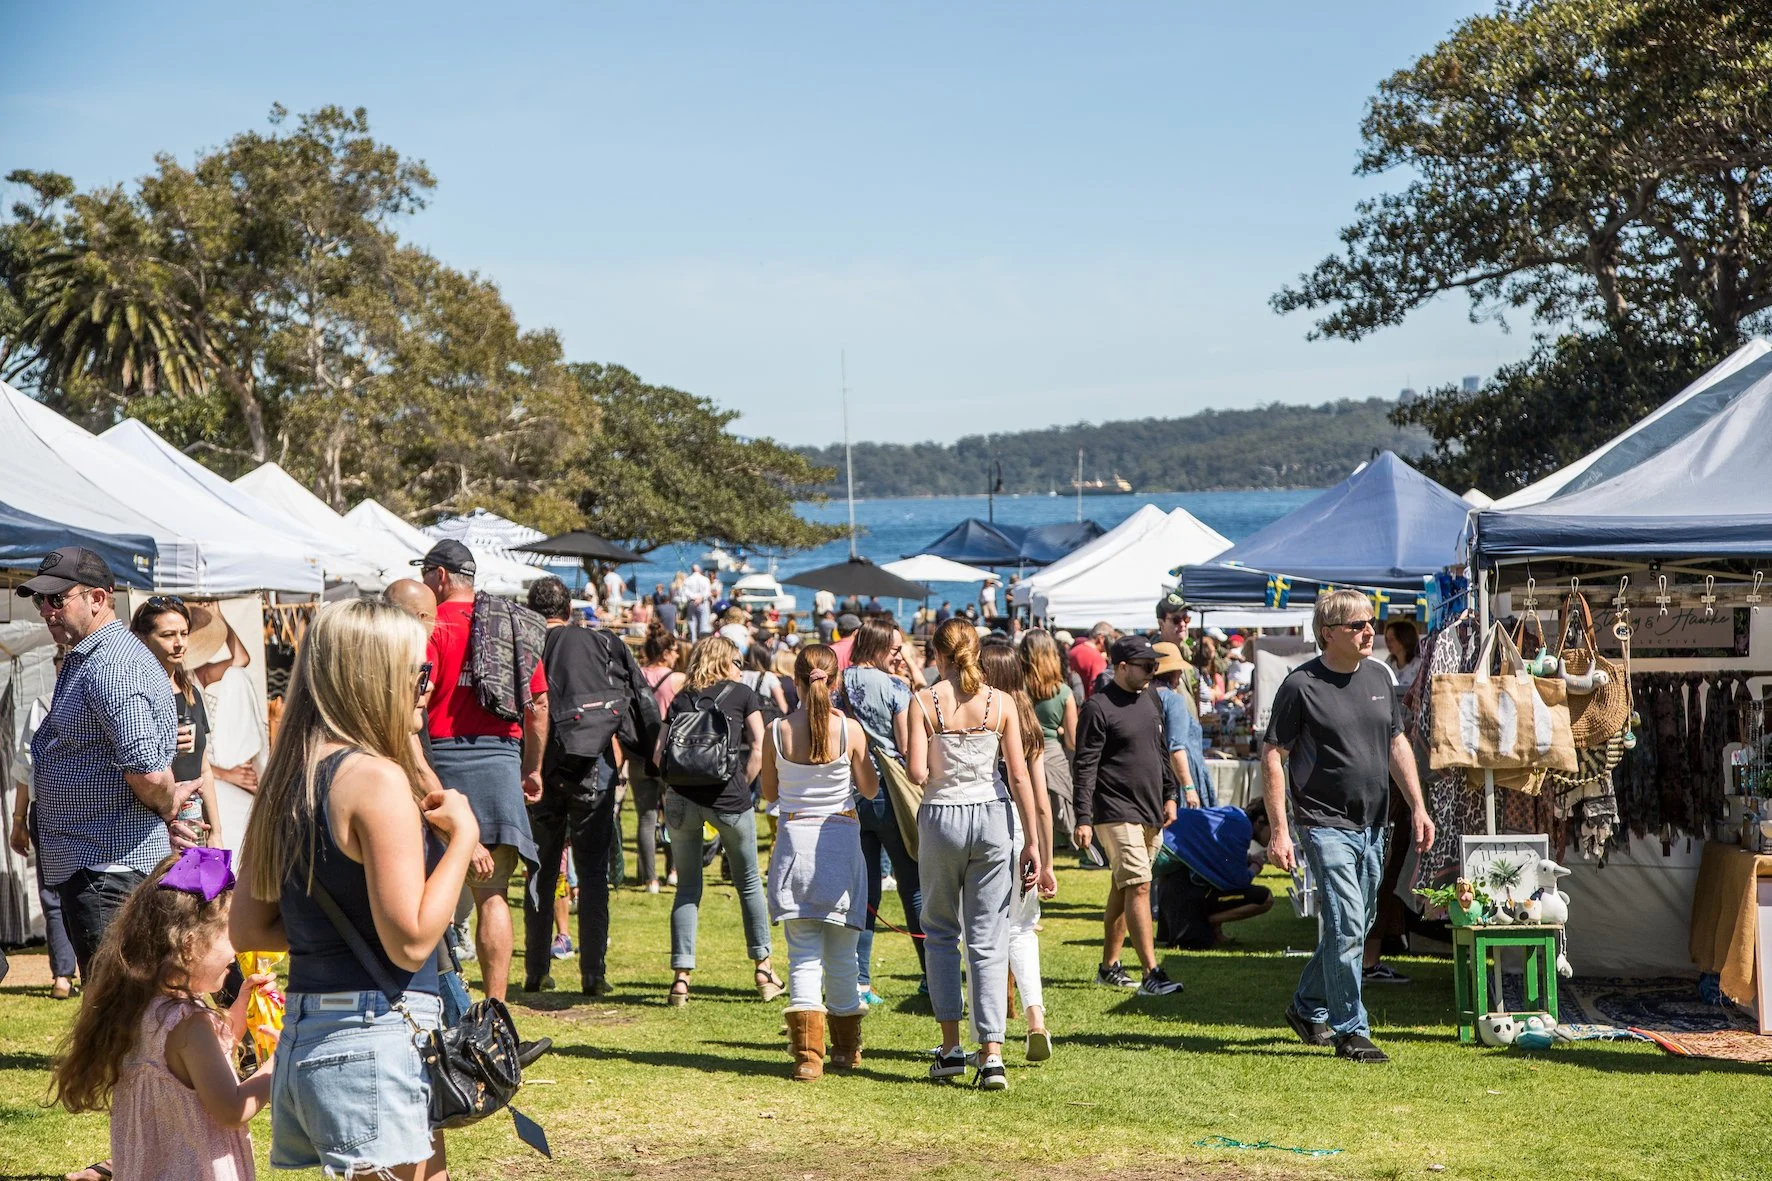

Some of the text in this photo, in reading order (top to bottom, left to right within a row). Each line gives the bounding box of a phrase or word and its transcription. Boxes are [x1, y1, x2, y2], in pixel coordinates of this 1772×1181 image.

[1494, 843, 1506, 855] 12
[1481, 850, 1491, 861] 11
[1472, 865, 1485, 876] 10
